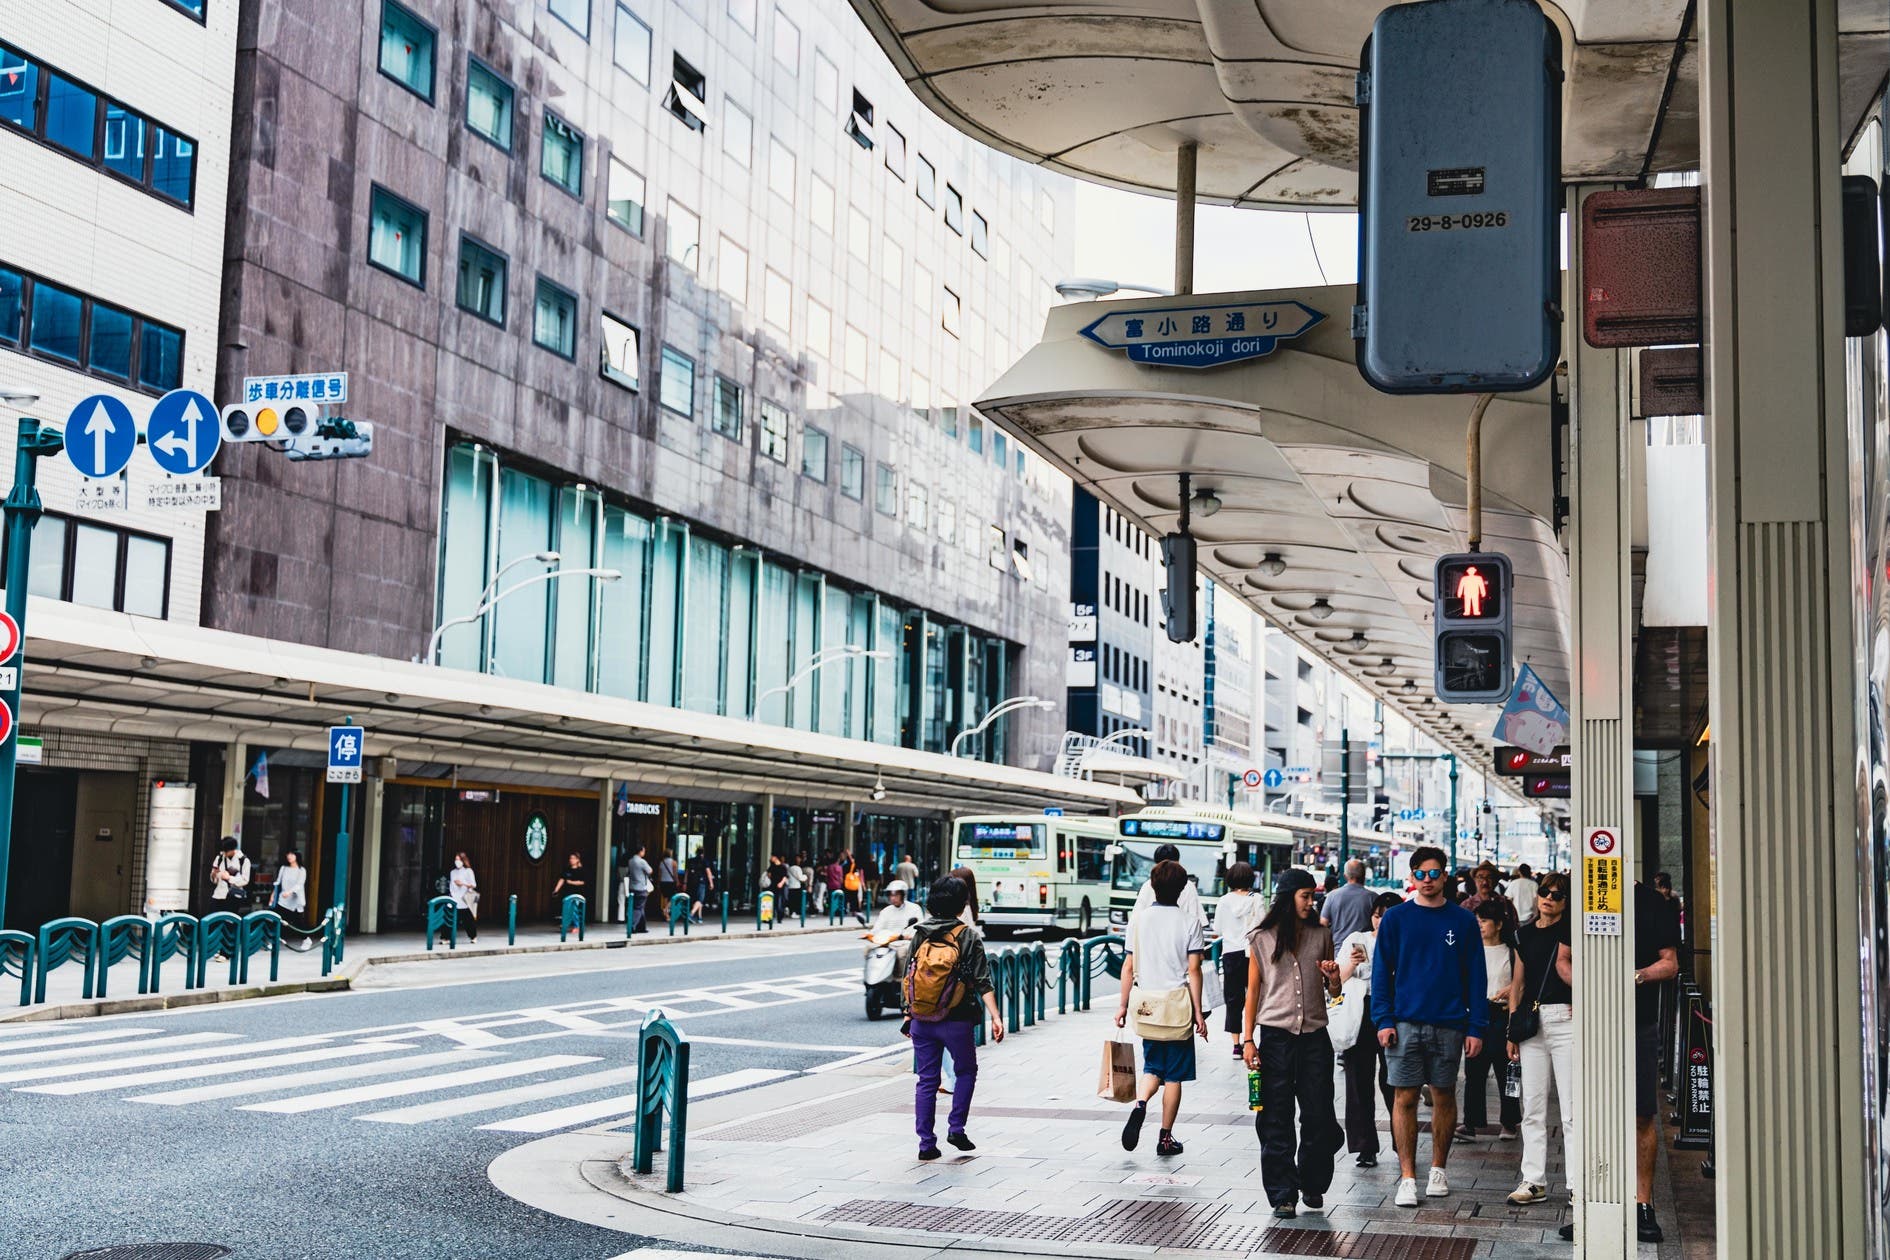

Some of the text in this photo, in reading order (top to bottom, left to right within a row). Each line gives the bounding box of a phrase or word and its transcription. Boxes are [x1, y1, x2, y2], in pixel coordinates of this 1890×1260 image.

[1410, 212, 1506, 232] 29-8-0926
[1124, 311, 1278, 339] 富小路通り
[1142, 338, 1260, 359] Tominokoji dori
[249, 379, 342, 402] 歩車分離信号
[1075, 650, 1093, 661] 3F
[335, 734, 357, 761] 停
[627, 802, 660, 815] TARBUCKS
[1597, 859, 1608, 911] 自転車通行止め
[1690, 1065, 1697, 1077] NO
[1697, 1065, 1711, 1113] 駐輪禁止
